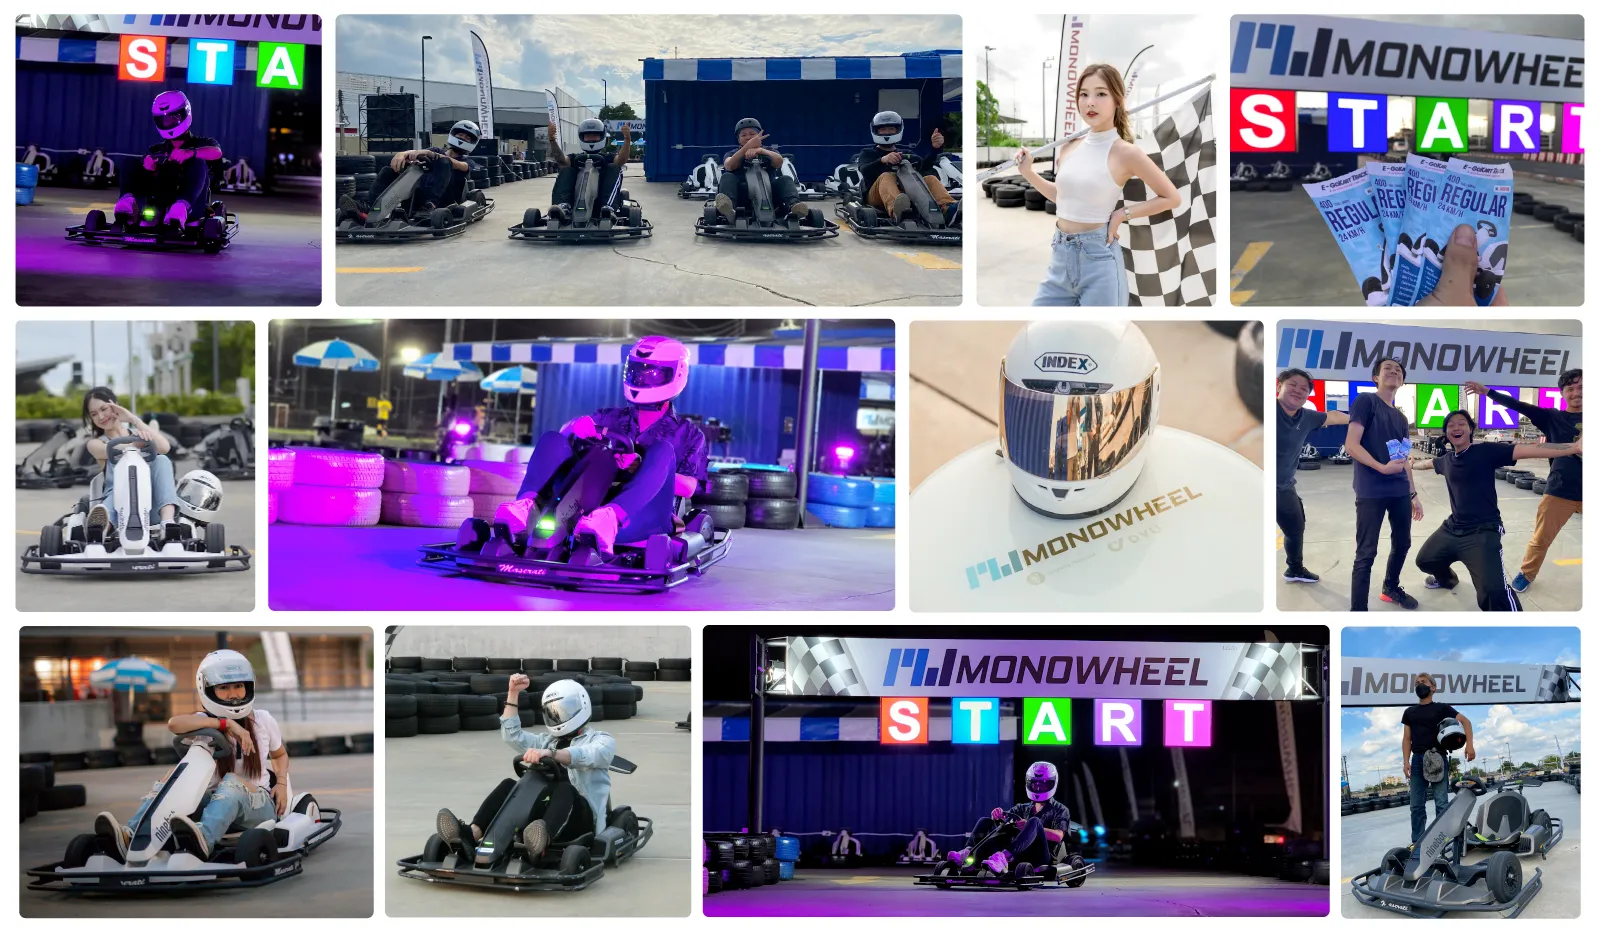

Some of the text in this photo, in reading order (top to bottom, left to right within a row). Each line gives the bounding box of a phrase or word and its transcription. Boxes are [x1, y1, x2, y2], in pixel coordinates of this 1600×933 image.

[126, 38, 299, 86] STA
[1376, 188, 1406, 209] REG
[1440, 182, 1508, 218] REGULAR
[1041, 355, 1089, 371] INDEX
[1022, 486, 1203, 566] MONOWHEEL
[498, 564, 547, 575] Maserati
[956, 655, 1208, 687] MONOWHEEL
[888, 700, 1205, 742] START
